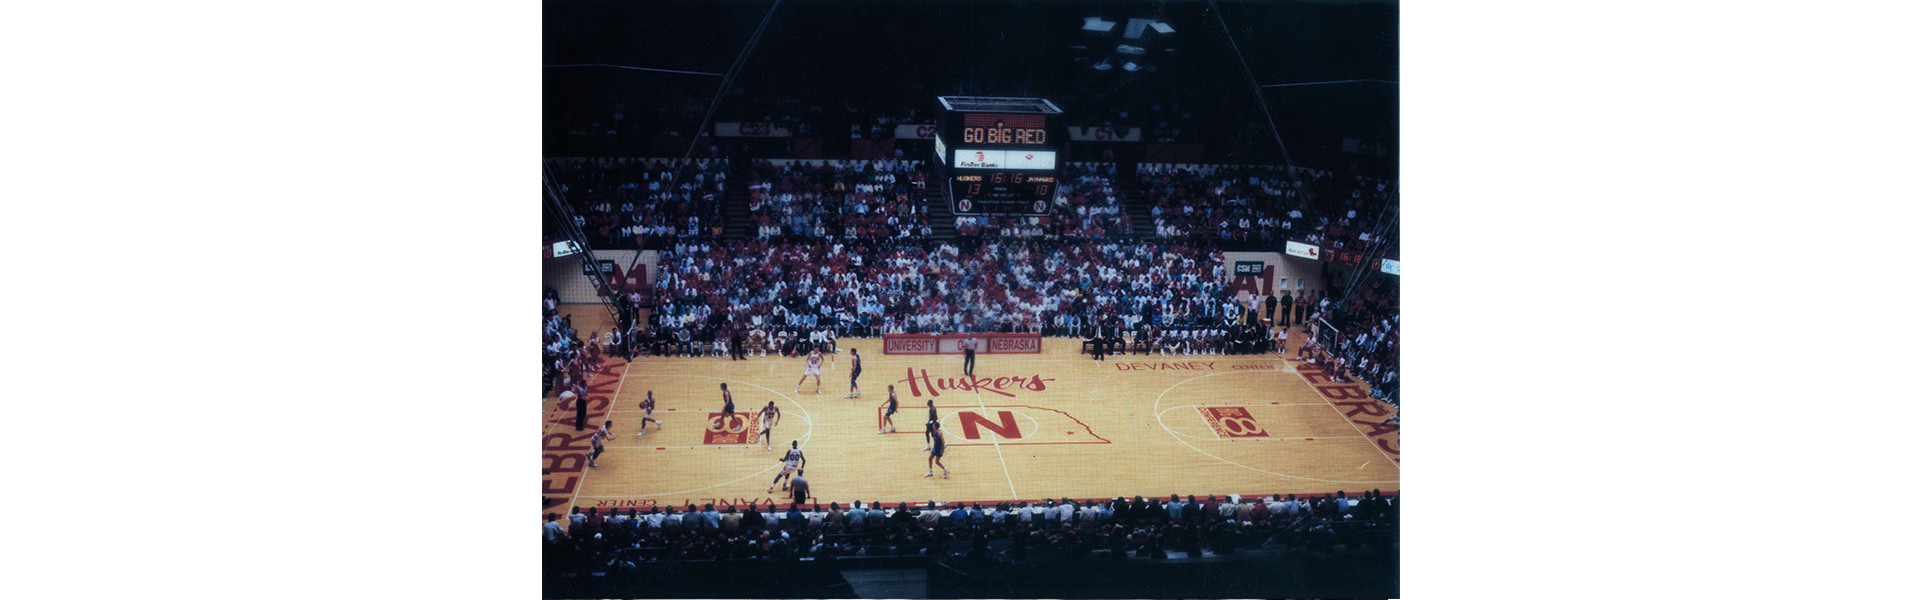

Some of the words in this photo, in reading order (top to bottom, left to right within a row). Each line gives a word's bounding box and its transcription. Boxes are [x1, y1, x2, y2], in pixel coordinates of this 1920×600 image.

[964, 127, 984, 143] GO
[987, 127, 1012, 144] BIG
[1015, 128, 1046, 144] RED
[968, 183, 981, 195] 13
[1036, 184, 1048, 196] 10
[960, 200, 970, 210] N
[1035, 201, 1045, 211] N
[1231, 265, 1275, 296] A1
[888, 340, 935, 351] UNIVERSITY
[992, 339, 1036, 351] NEBRASKA
[1115, 362, 1215, 371] DEVANEY
[898, 366, 1056, 398] Huskers
[958, 411, 1022, 440] N
